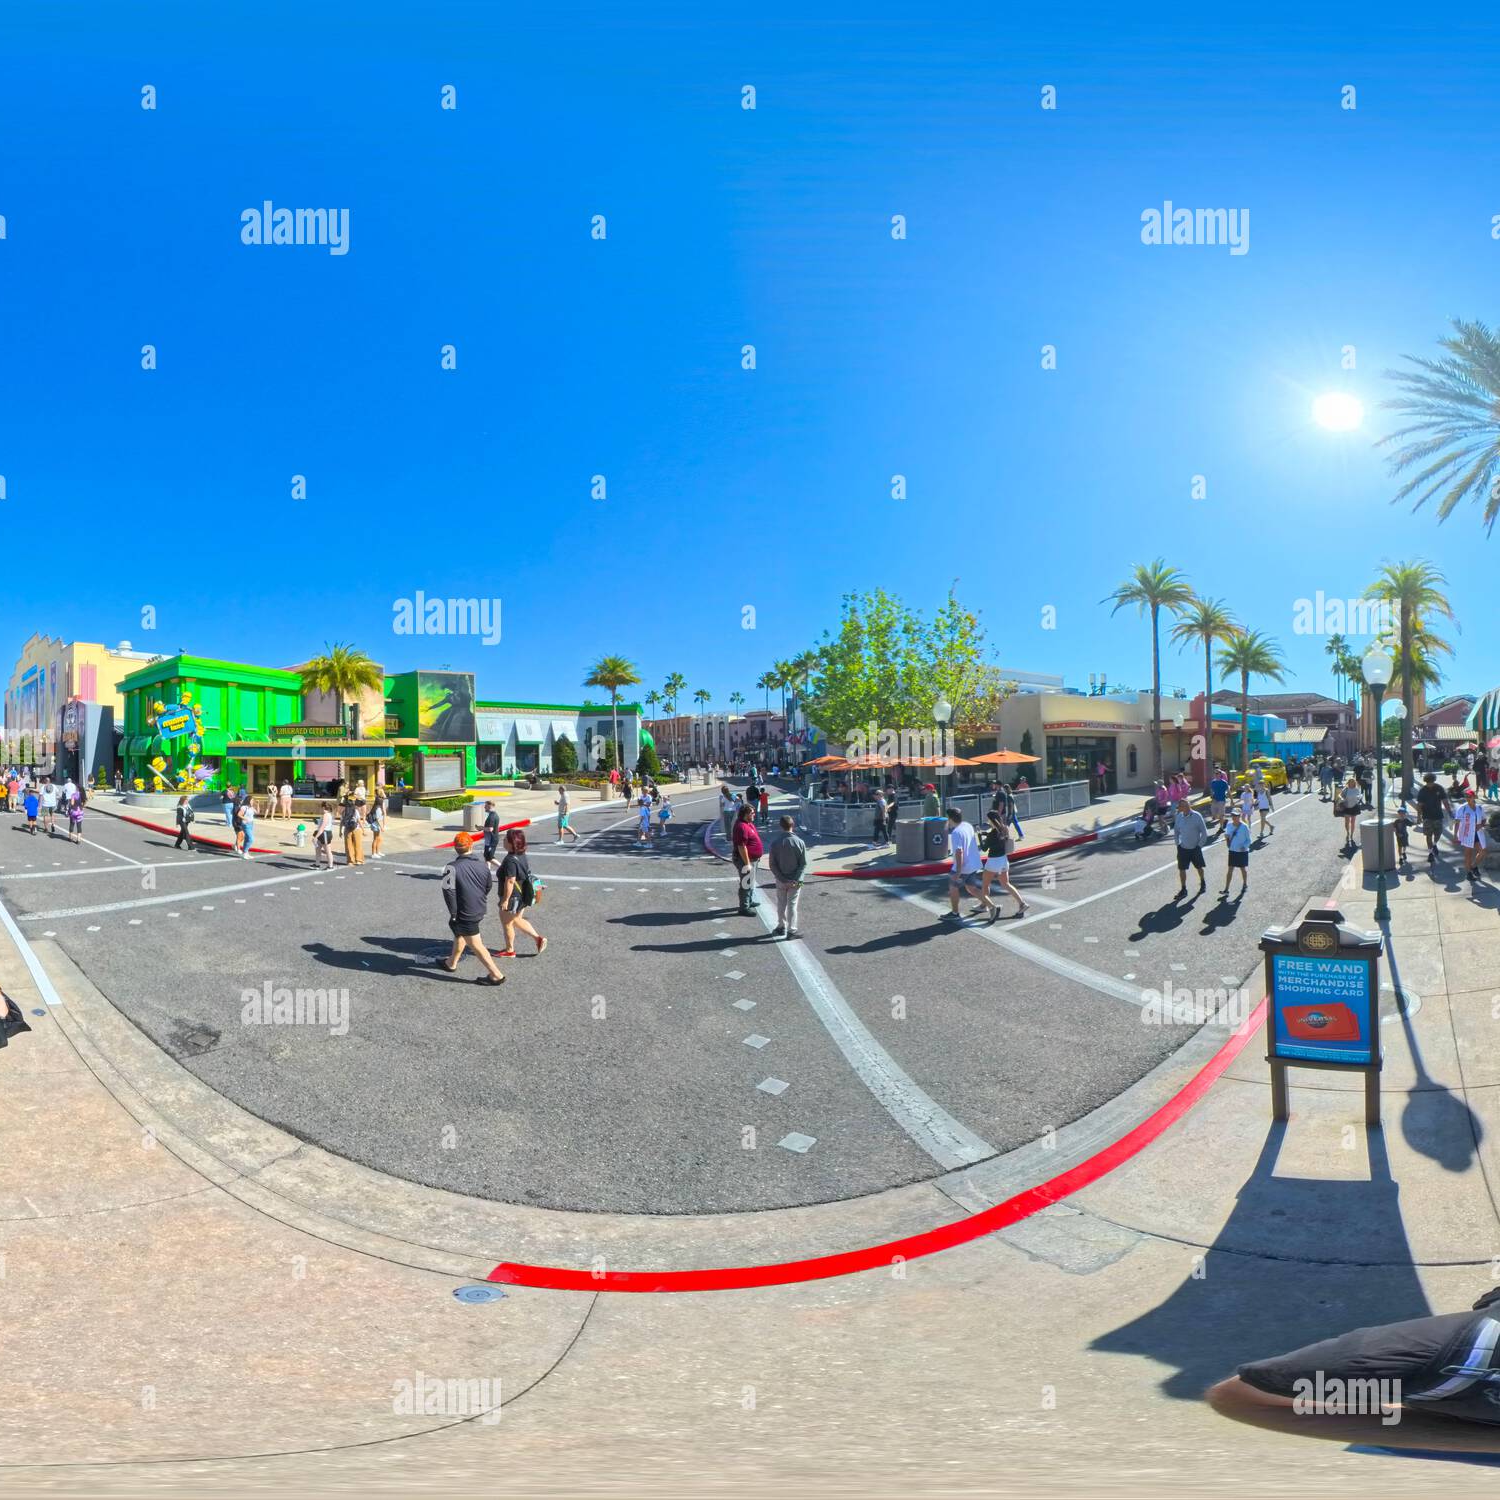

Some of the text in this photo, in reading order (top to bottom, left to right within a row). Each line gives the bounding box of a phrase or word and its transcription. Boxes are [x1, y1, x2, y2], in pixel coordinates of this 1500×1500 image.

[326, 727, 343, 735] EATS
[1278, 960, 1364, 974] FREE WAND
[1278, 976, 1364, 989] MERCHANDISE
[1278, 984, 1364, 997] SHOPPING CARD
